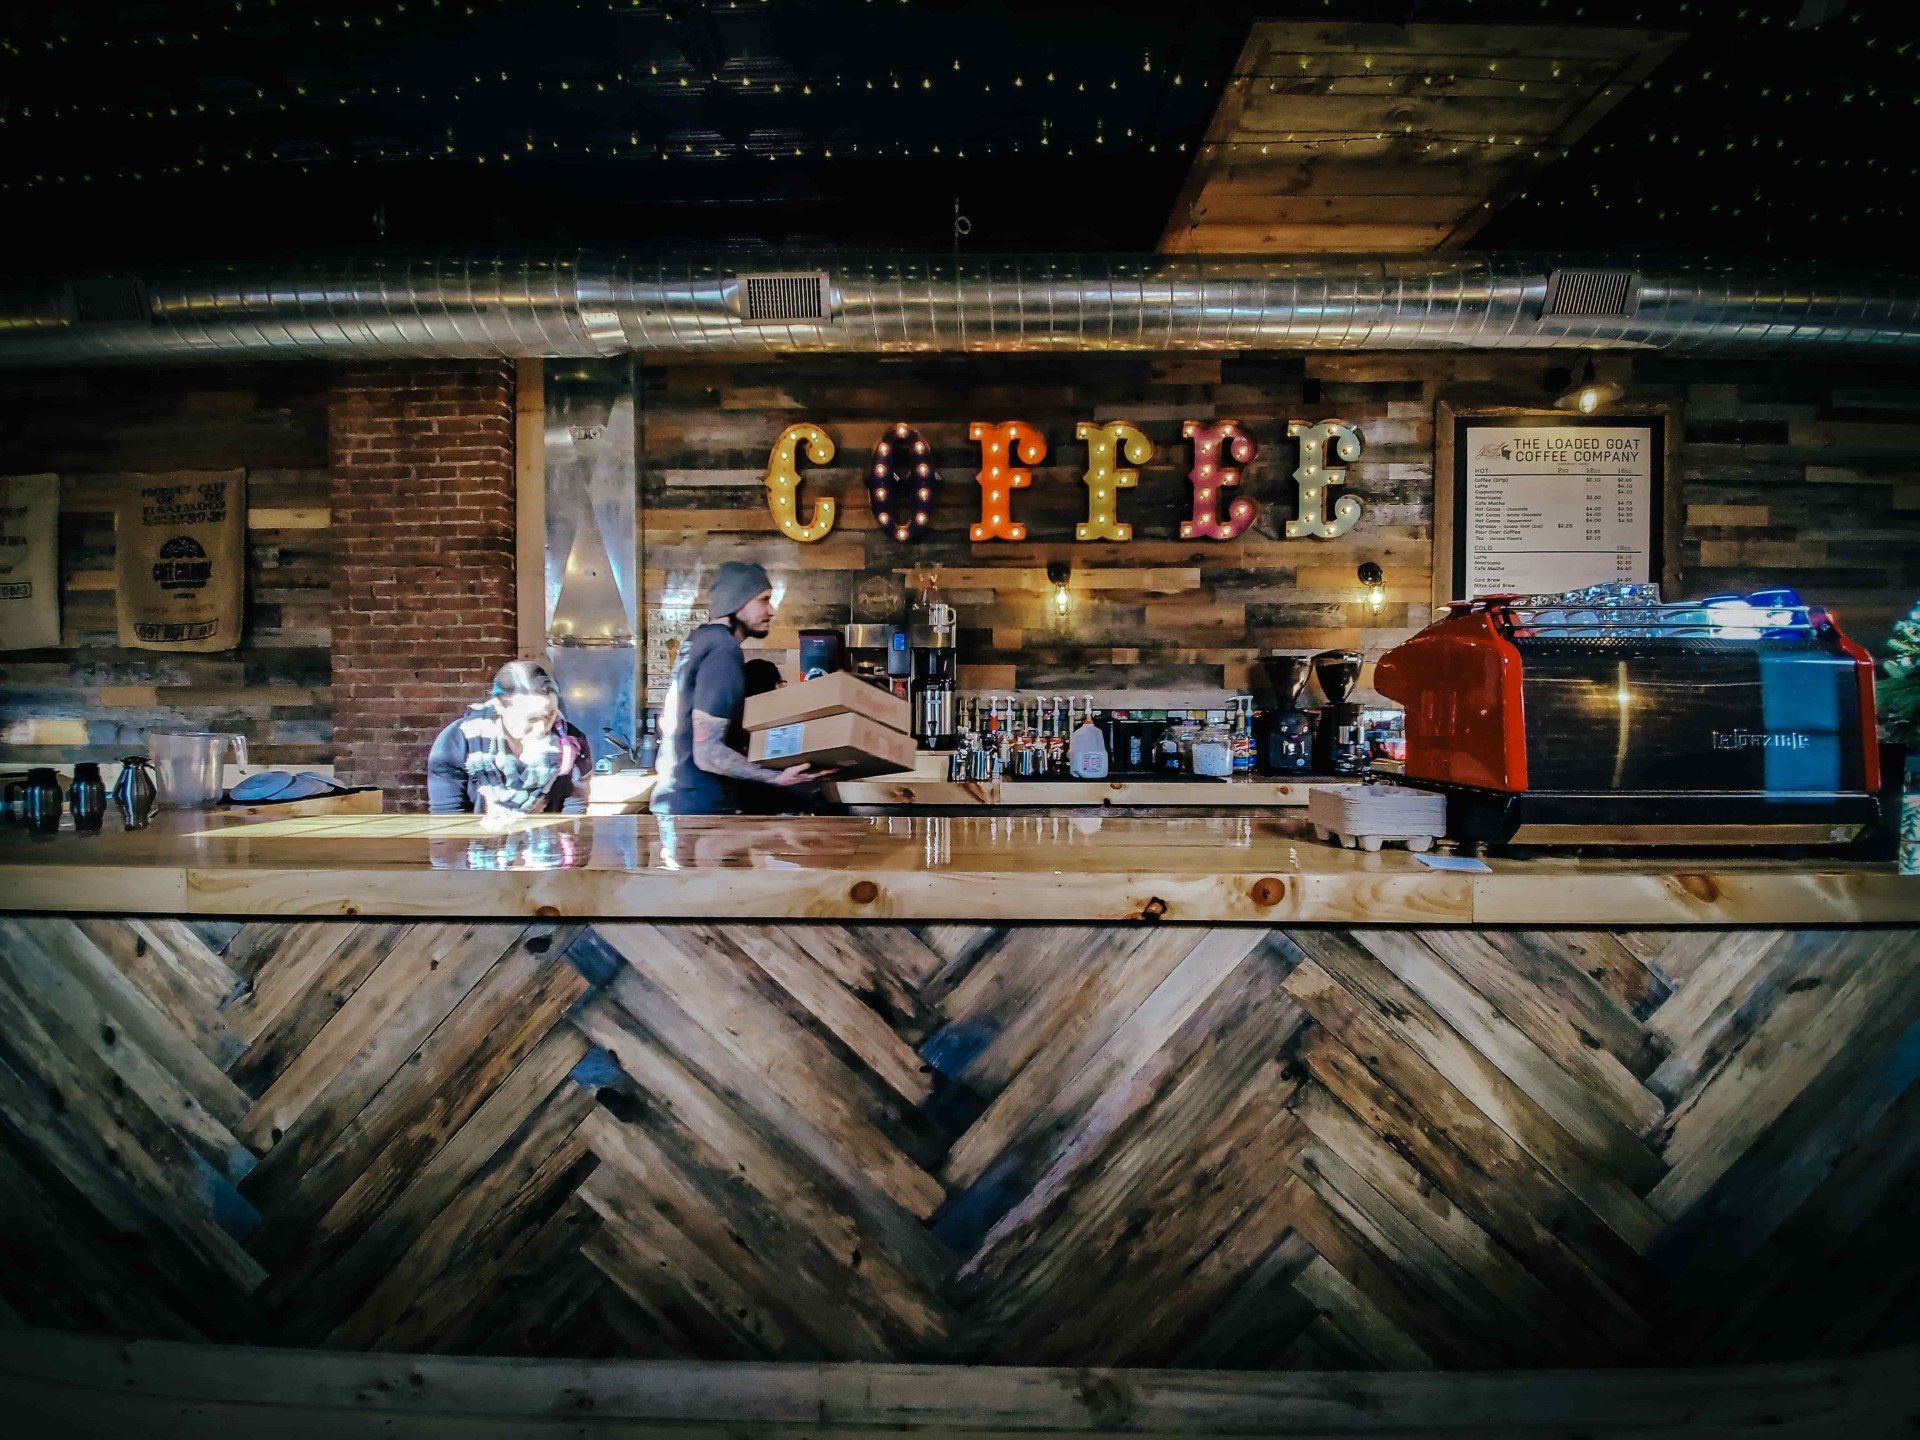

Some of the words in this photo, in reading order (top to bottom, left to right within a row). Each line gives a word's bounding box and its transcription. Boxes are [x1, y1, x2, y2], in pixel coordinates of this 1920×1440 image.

[1514, 438, 1540, 450] THE
[1547, 438, 1600, 450] LOADED
[1606, 438, 1641, 450] GOAT
[1515, 450, 1567, 462] COFFEE
[1574, 450, 1640, 462] COMPANY
[763, 419, 1365, 543] COFFEE
